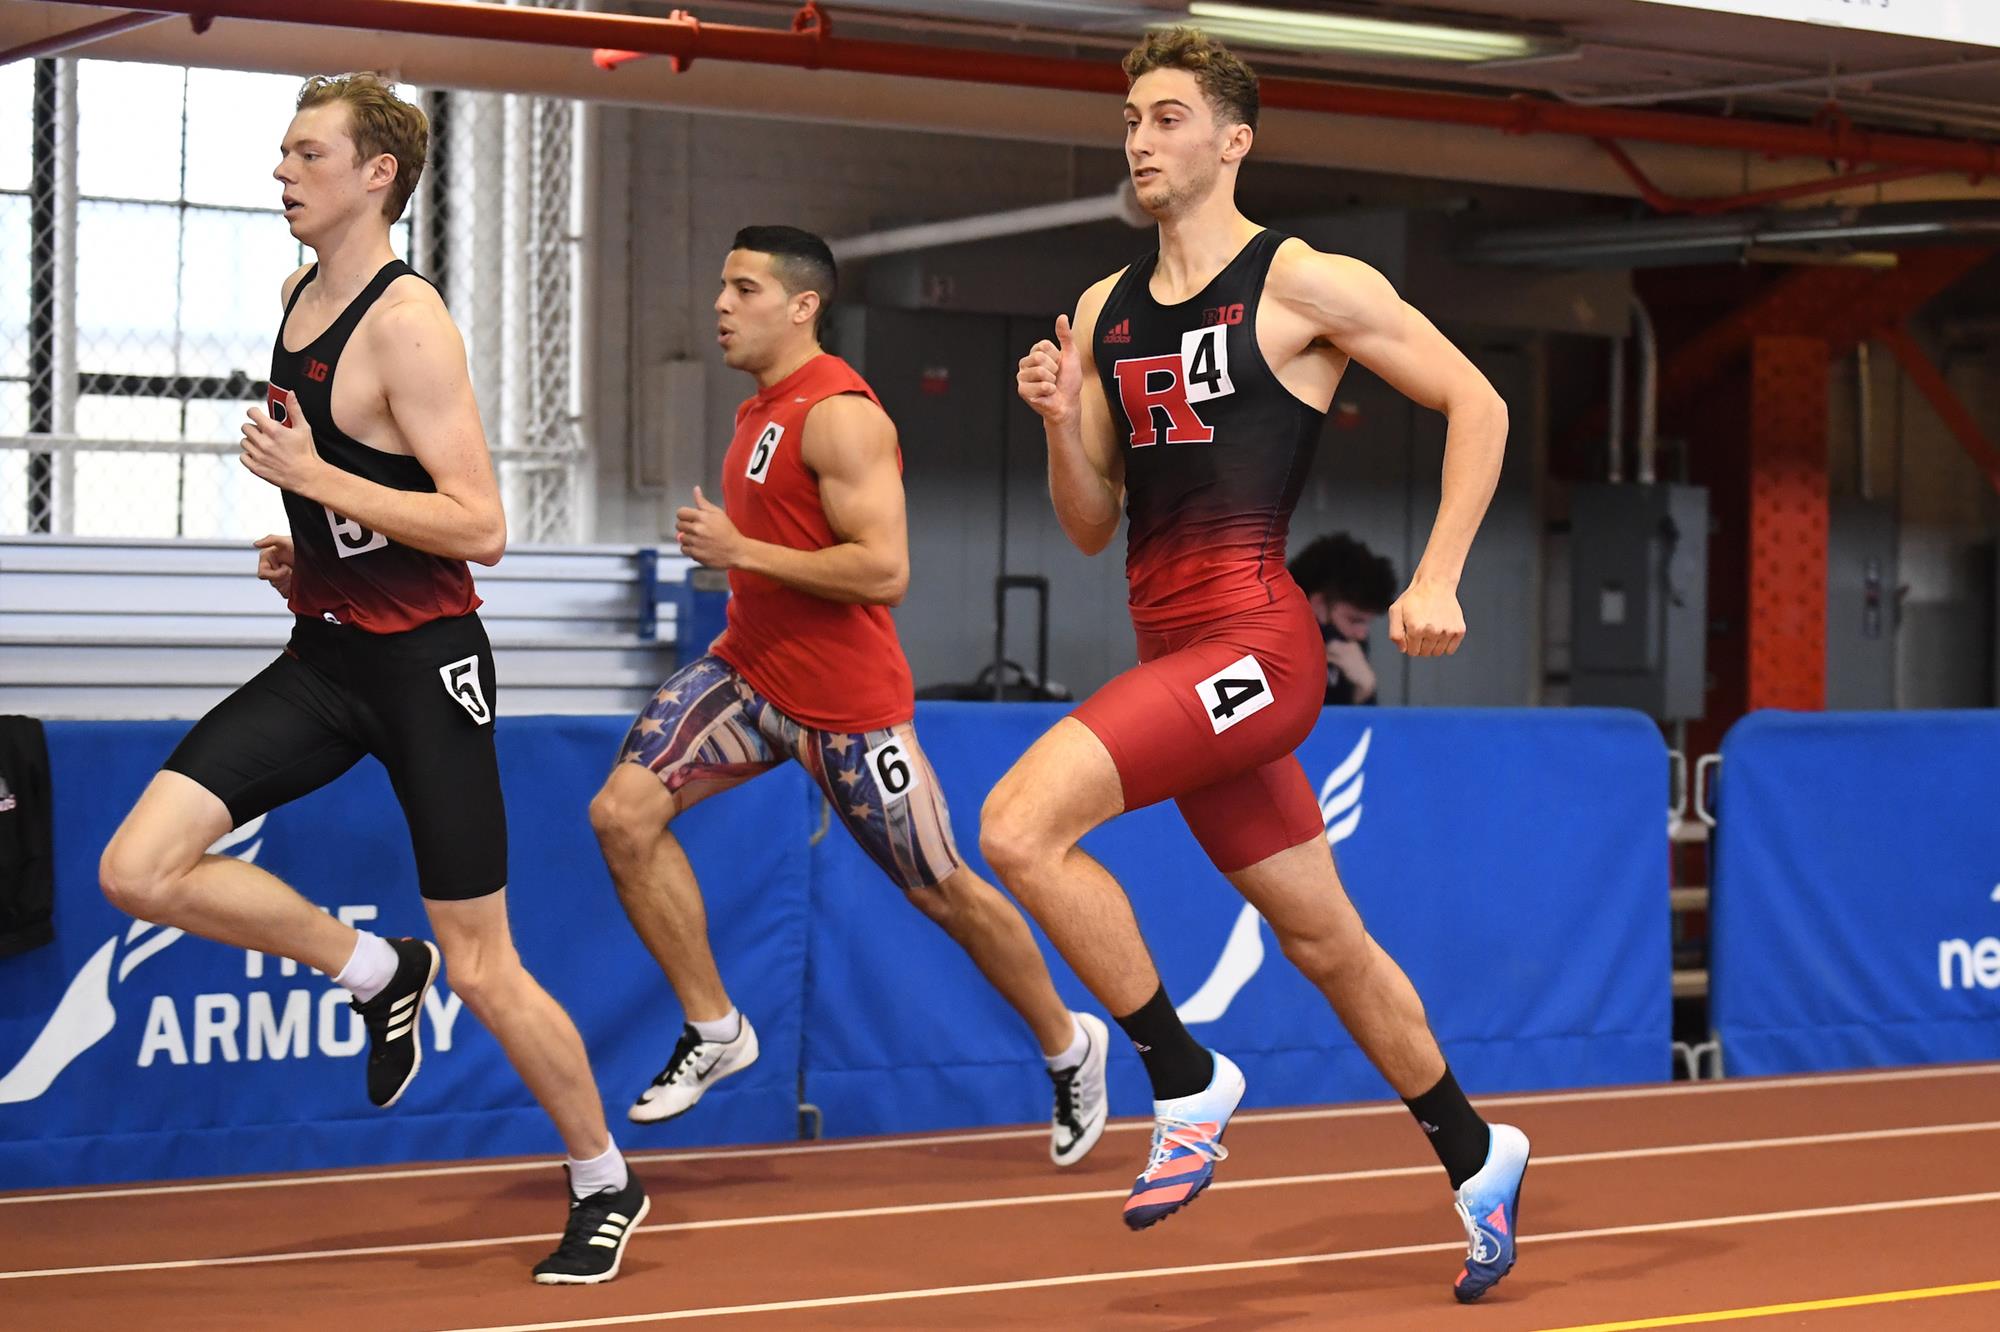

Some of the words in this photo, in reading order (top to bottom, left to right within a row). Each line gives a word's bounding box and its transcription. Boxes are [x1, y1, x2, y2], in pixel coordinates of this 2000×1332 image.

[1189, 331, 1221, 394] 4
[1114, 353, 1214, 448] R
[750, 427, 776, 475] 6
[449, 663, 485, 717] 5
[1212, 679, 1264, 719] 4
[877, 745, 911, 794] 6
[137, 983, 463, 1067] ARMOY
